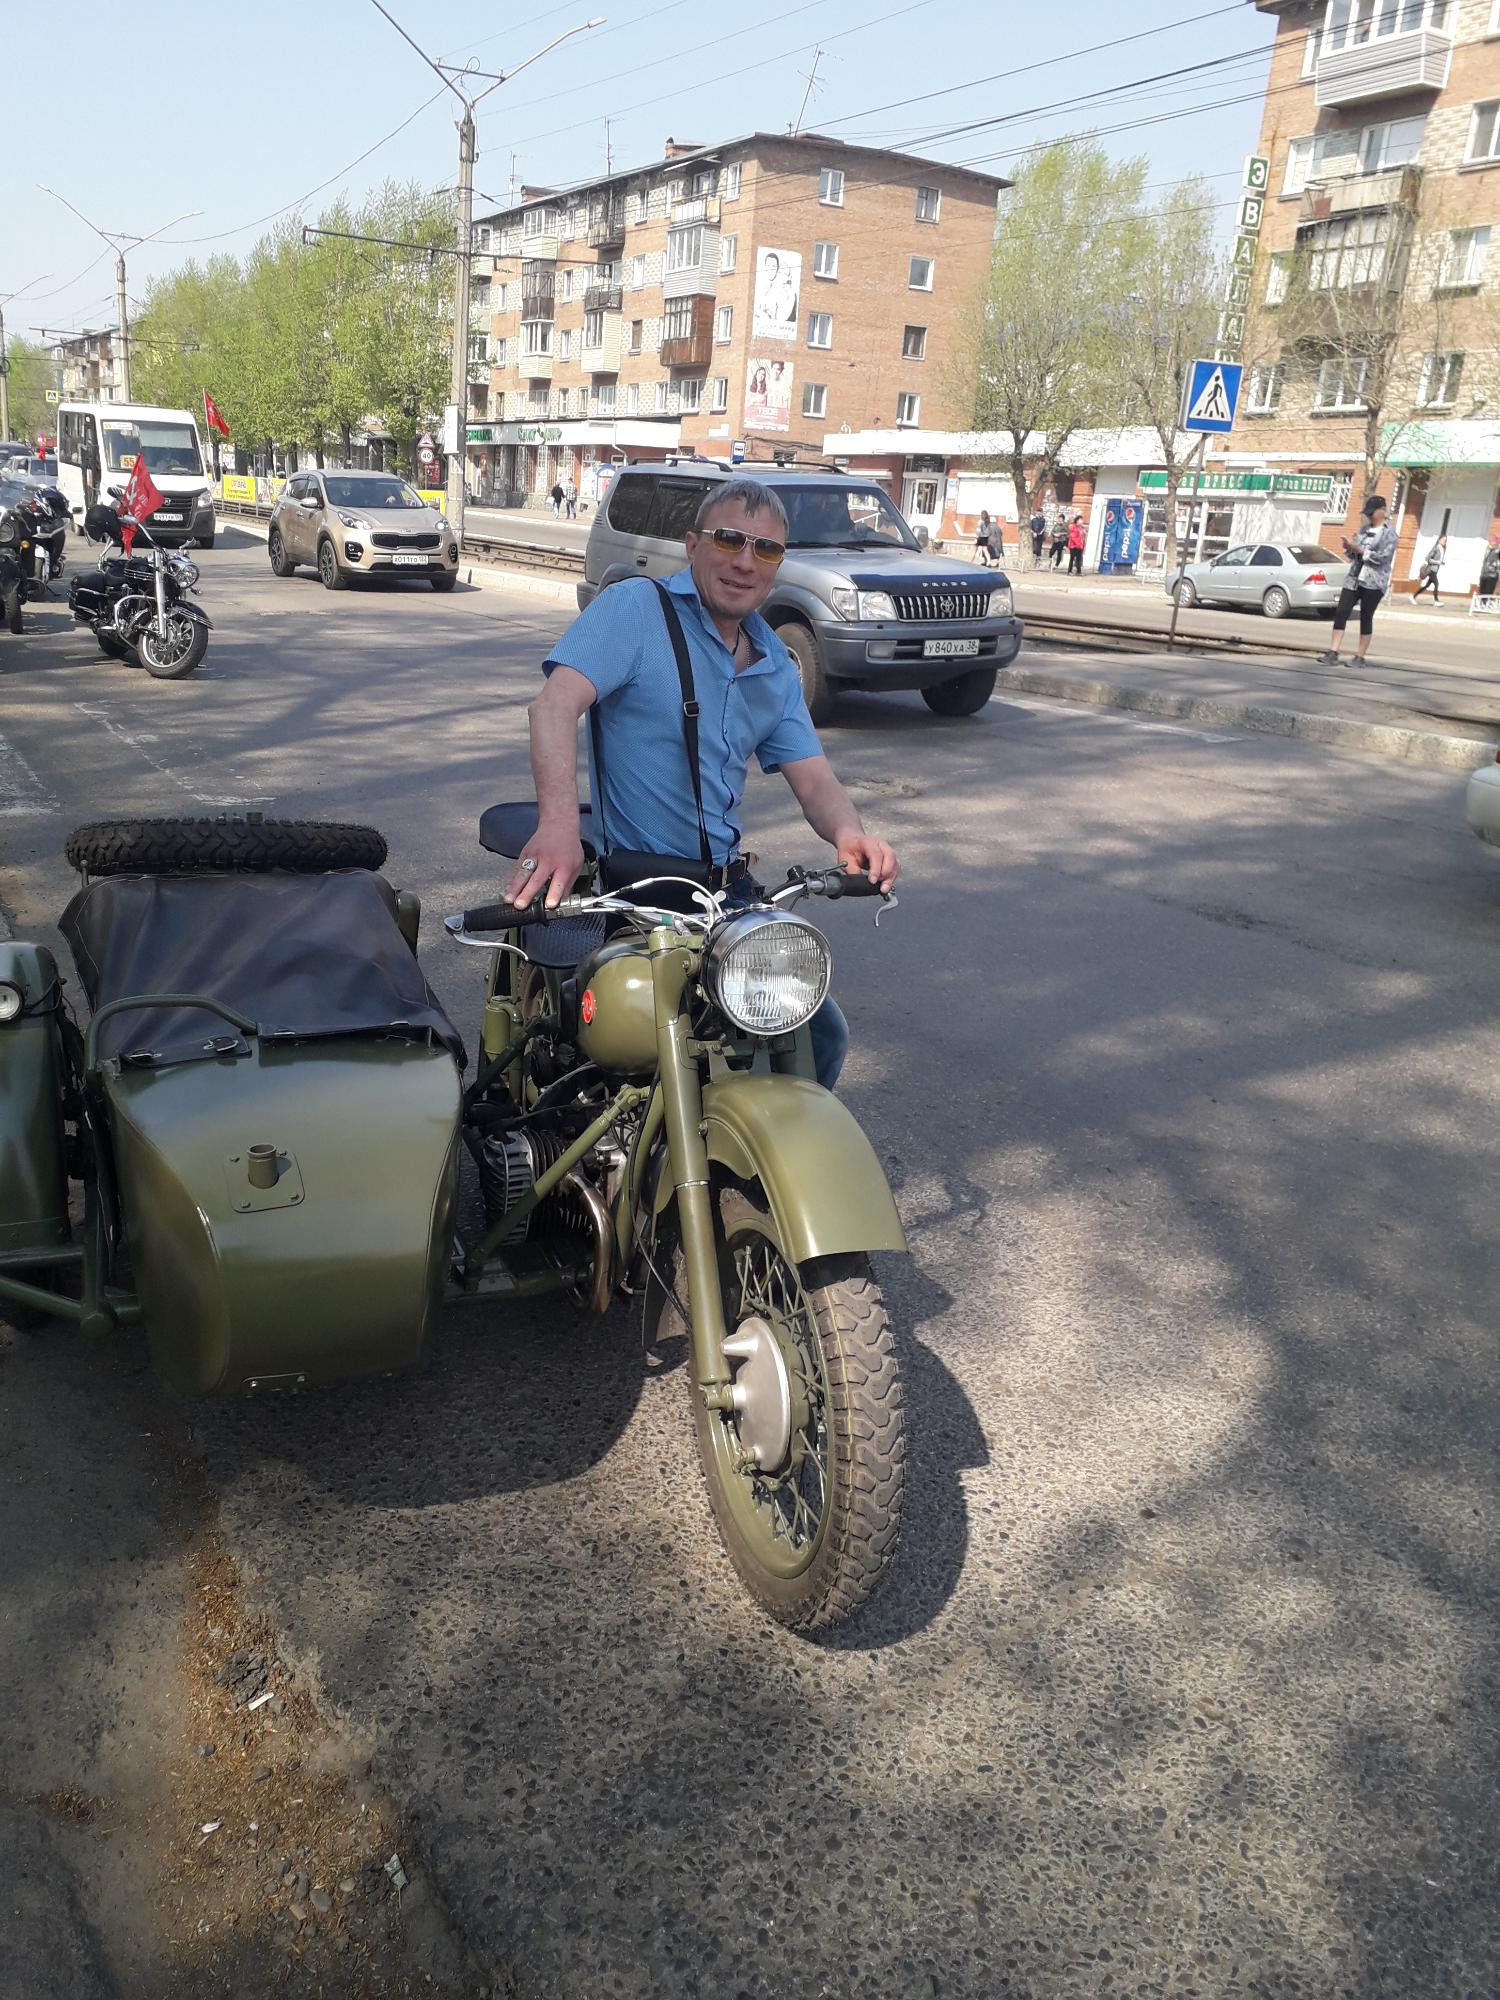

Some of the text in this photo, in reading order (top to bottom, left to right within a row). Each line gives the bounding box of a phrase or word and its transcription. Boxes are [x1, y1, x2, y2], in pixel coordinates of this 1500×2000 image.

[123, 457, 135, 467] 55
[1102, 531, 1111, 561] pepsi
[1121, 528, 1131, 559] pepsi
